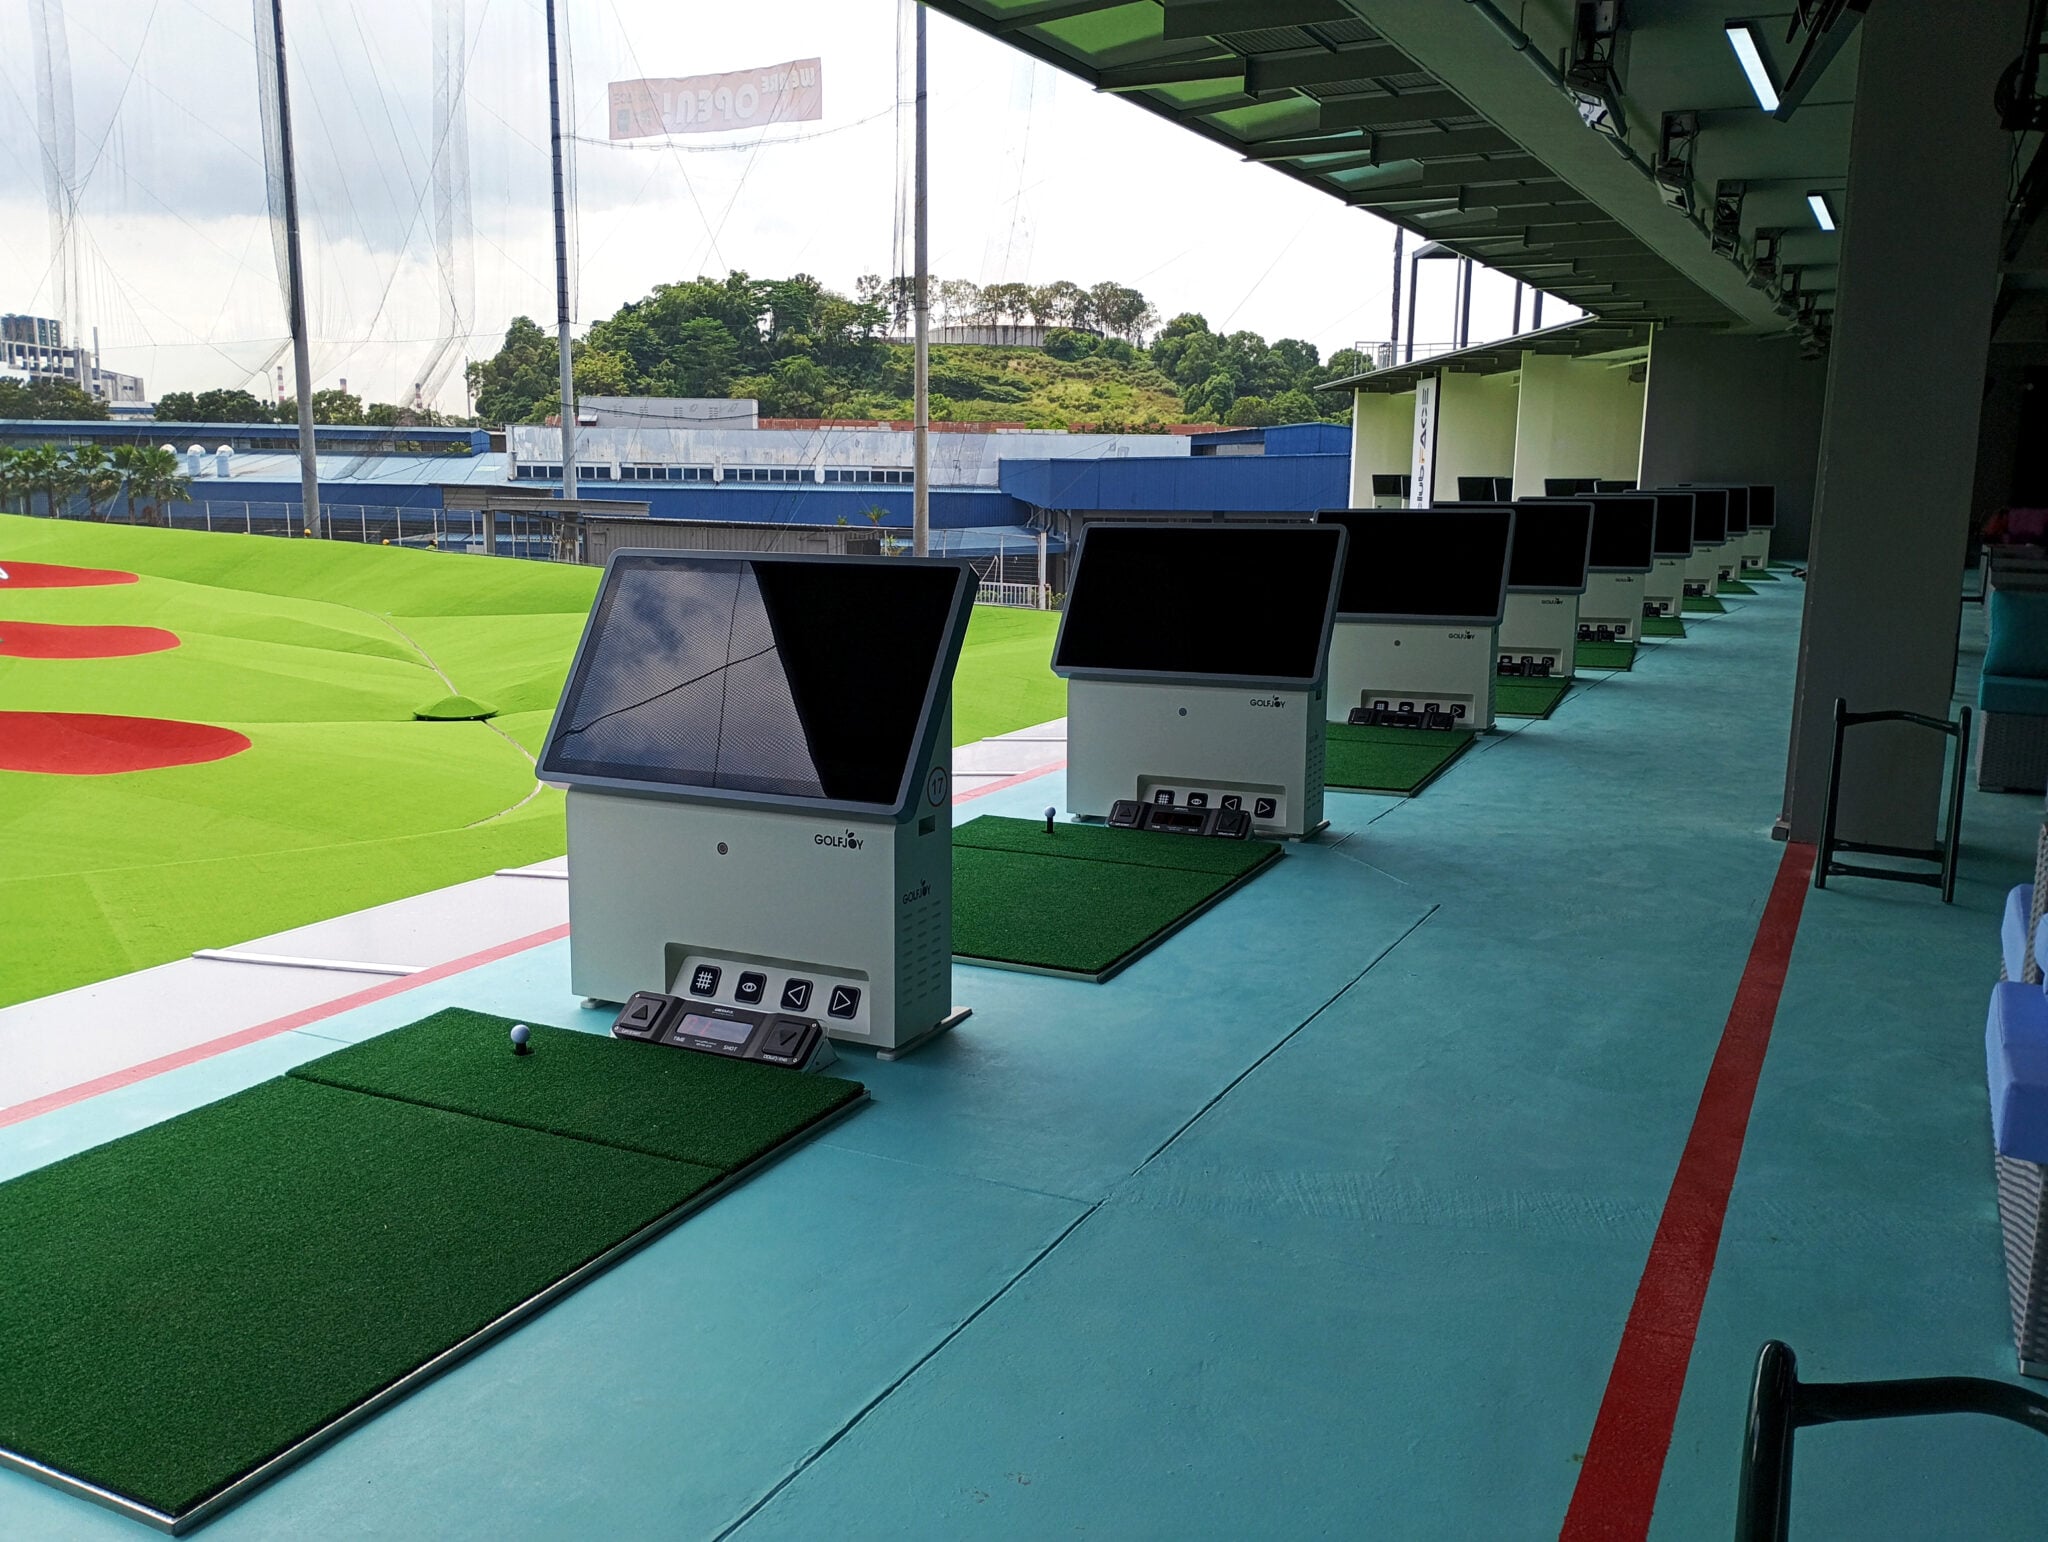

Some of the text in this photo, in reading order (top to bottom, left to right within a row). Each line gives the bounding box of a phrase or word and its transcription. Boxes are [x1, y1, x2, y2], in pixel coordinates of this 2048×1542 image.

[1249, 696, 1286, 709] GOLFJOY
[931, 777, 944, 796] 17
[814, 830, 864, 850] GOLFJOY
[902, 880, 932, 905] GOLFJOY
[722, 1044, 738, 1053] SHOT
